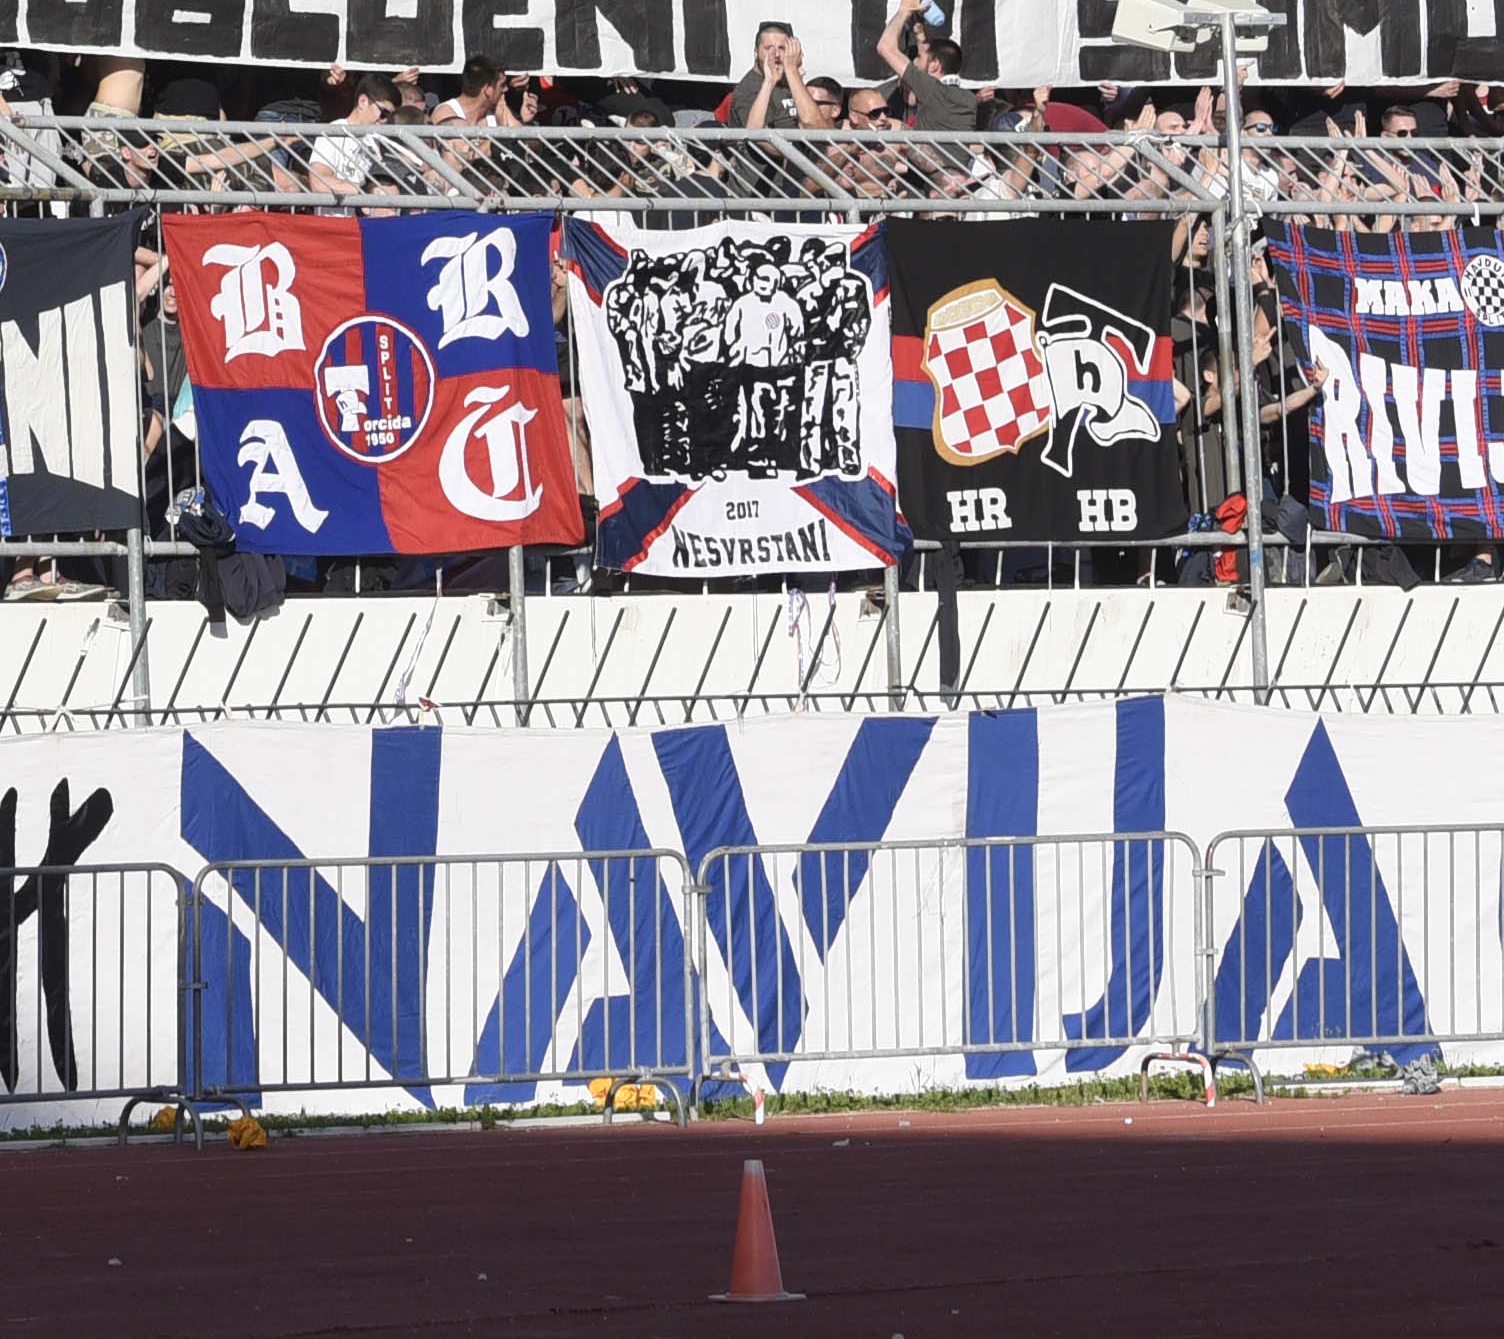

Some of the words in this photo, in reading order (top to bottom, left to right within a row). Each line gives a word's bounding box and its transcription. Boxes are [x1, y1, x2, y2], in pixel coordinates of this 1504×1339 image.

[725, 500, 761, 521] 2017
[945, 487, 1013, 532] HR
[1076, 488, 1138, 532] HB
[672, 518, 832, 569] NESVRSTANI
